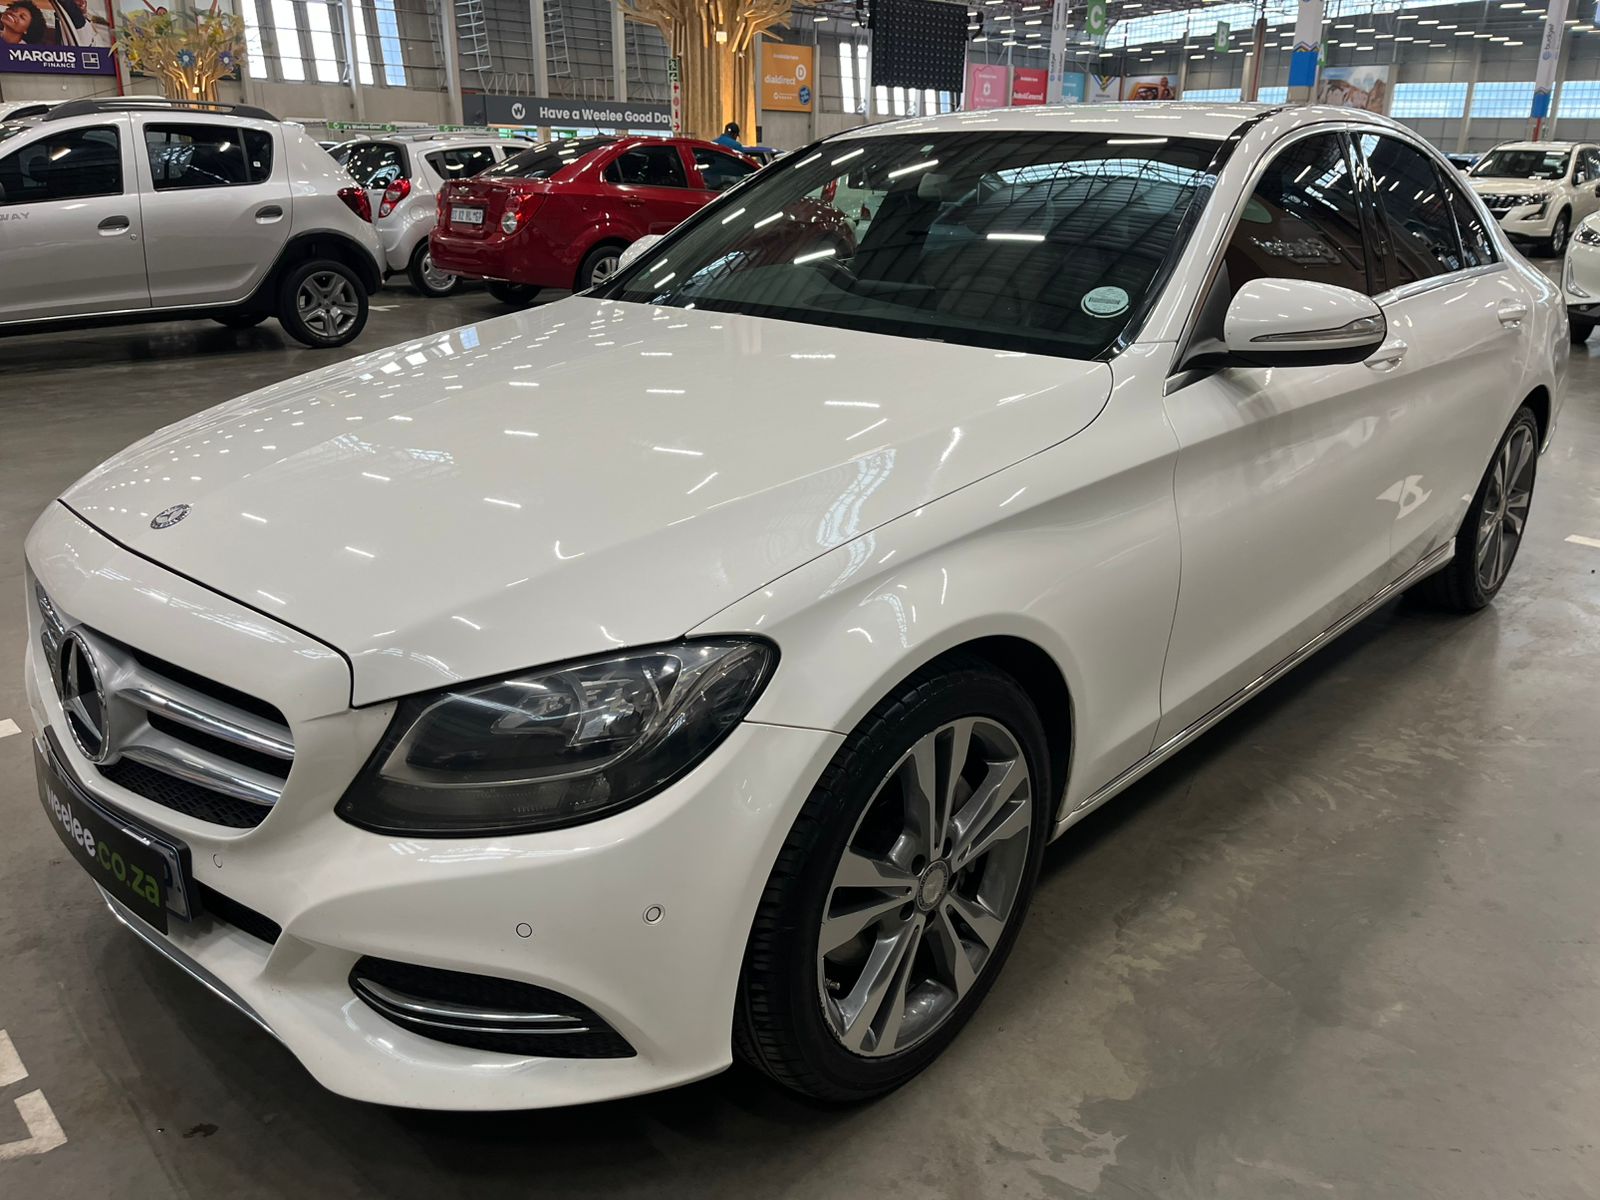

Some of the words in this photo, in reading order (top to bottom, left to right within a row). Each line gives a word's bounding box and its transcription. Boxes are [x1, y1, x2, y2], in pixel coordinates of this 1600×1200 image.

[1090, 5, 1103, 29] C
[9, 49, 76, 62] MARQUIS
[539, 106, 570, 120] Have
[572, 110, 580, 120] a
[582, 108, 623, 122] Weelee
[624, 110, 652, 124] Good
[654, 112, 672, 128] Day
